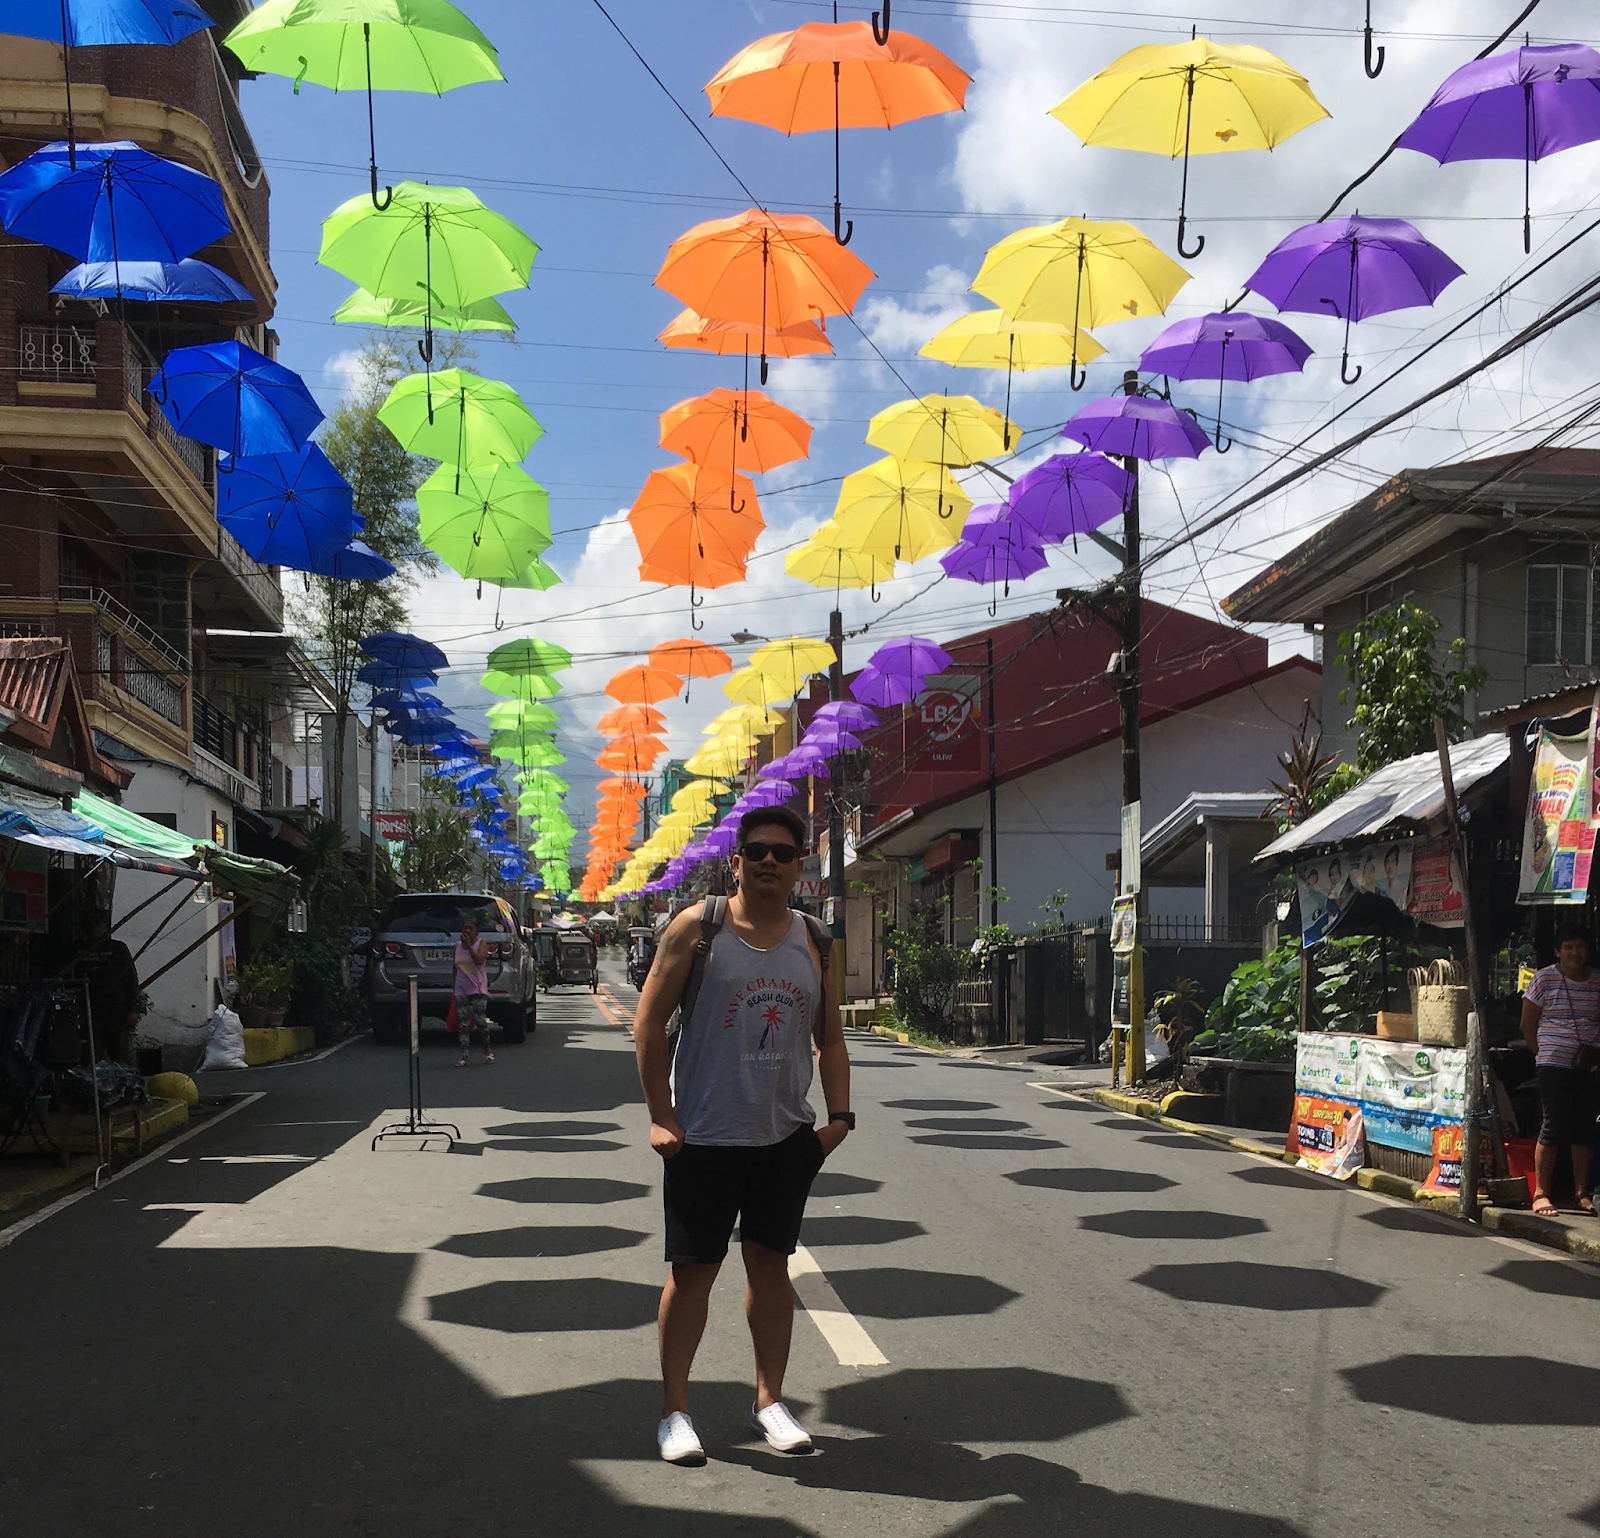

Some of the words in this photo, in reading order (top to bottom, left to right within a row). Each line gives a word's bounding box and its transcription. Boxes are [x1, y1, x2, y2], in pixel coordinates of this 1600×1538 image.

[921, 704, 964, 723] LBC
[932, 753, 953, 761] LILIW
[747, 993, 773, 1008] BEACH
[775, 993, 795, 1008] CLUB
[723, 989, 746, 1029] WAVE
[740, 1052, 756, 1061] SAN
[1306, 1066, 1321, 1077] Smart
[1321, 1068, 1332, 1079] LTE
[1371, 1076, 1387, 1088] Smart
[1388, 1079, 1400, 1091] LTE
